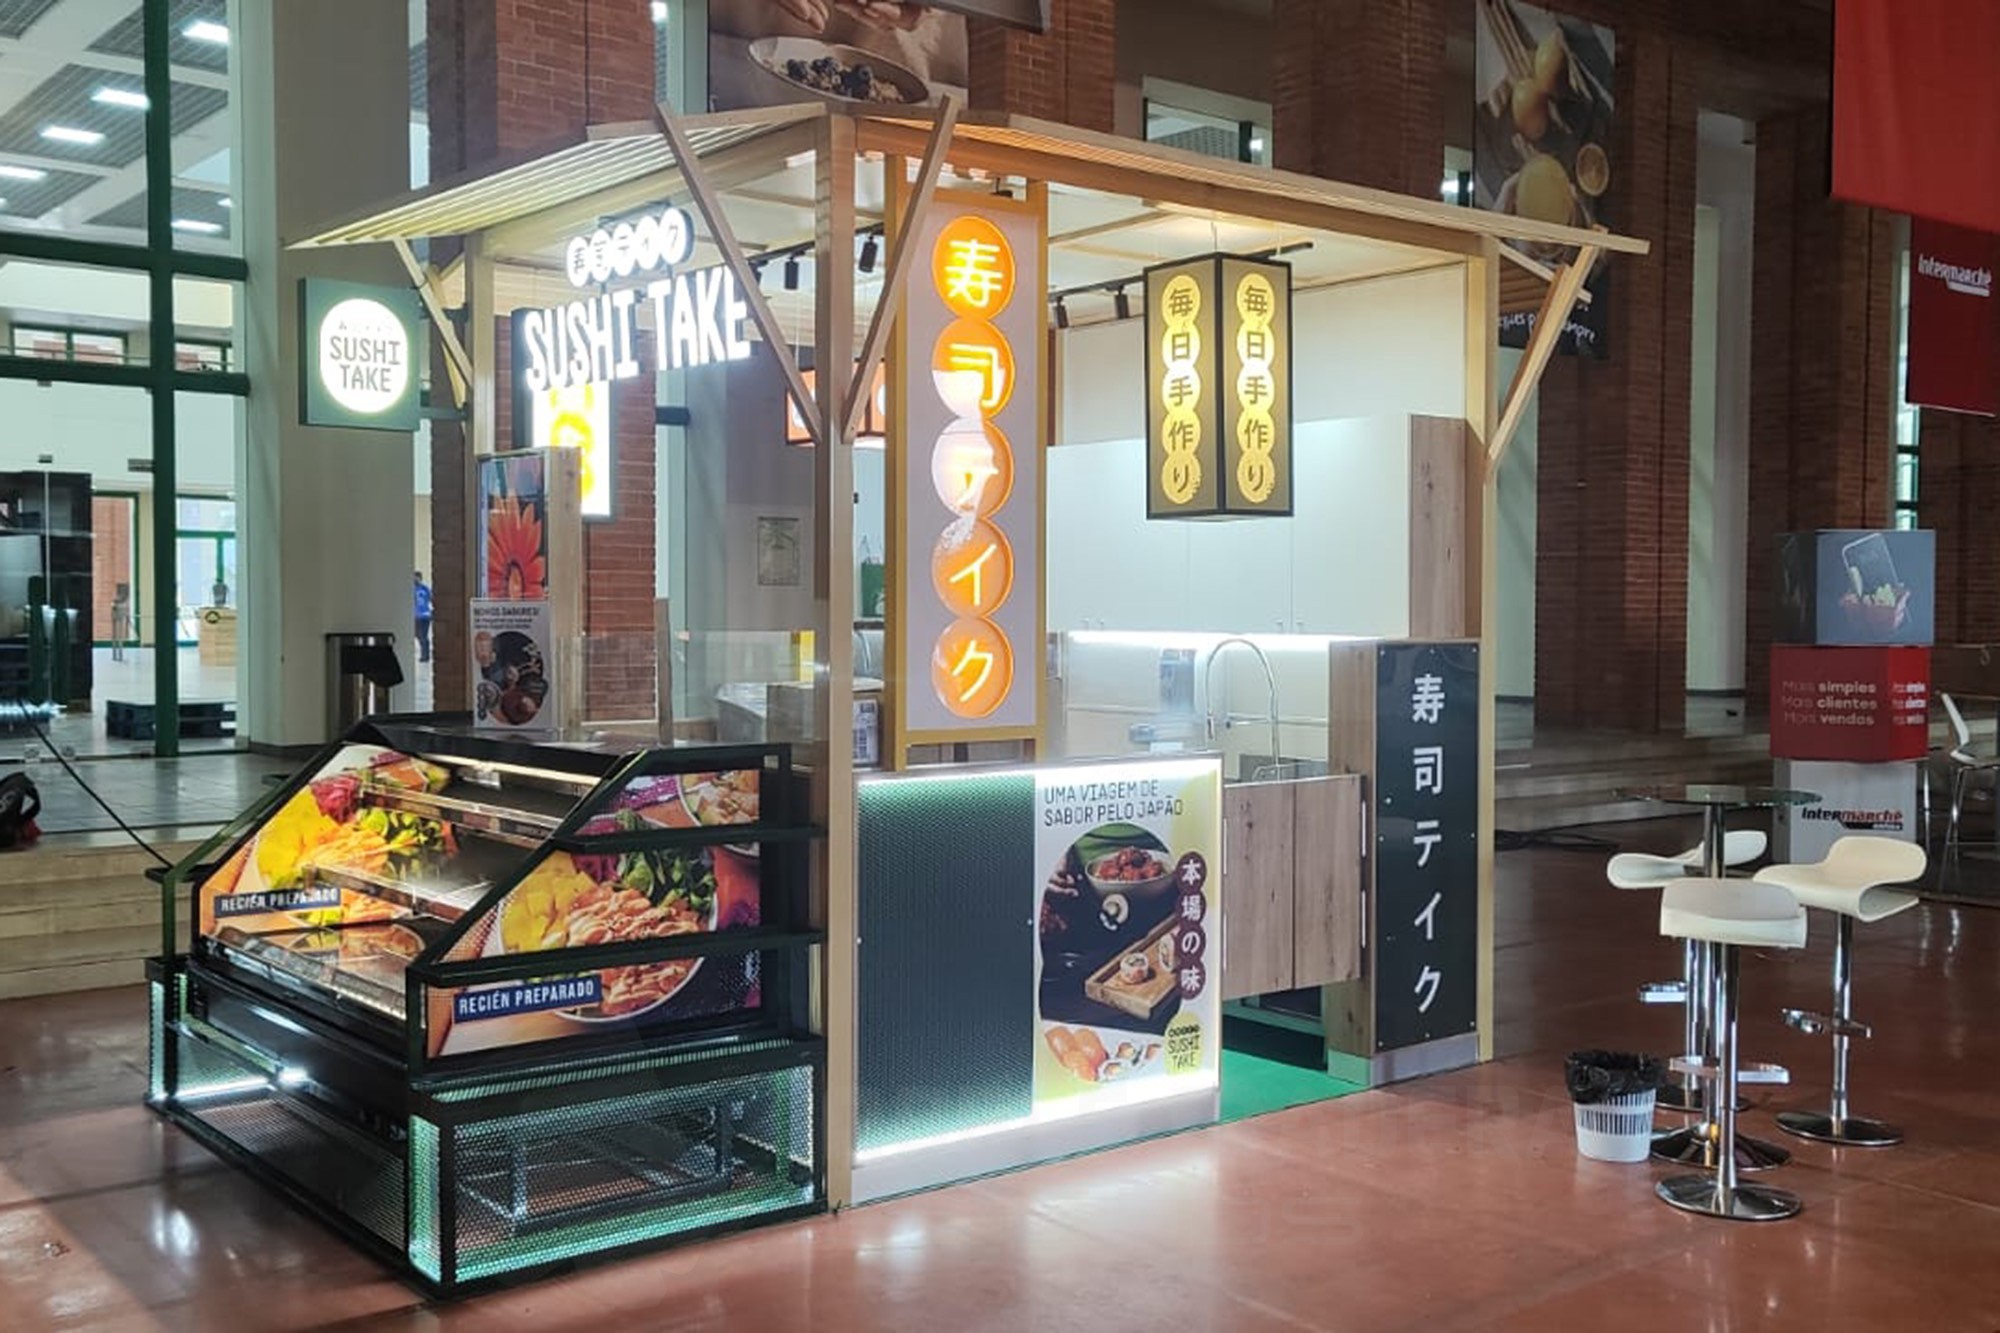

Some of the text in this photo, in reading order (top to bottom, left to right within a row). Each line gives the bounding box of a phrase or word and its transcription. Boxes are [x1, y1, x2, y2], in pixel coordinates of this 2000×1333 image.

[524, 265, 751, 391] SUSHI TAKE
[329, 335, 401, 365] SUSHI
[339, 363, 392, 393] TAKE
[1167, 286, 1195, 494] 毎日手作り
[1242, 283, 1269, 493] 毎日手作り
[1816, 696, 1878, 710] clientes
[1818, 681, 1877, 696] simples
[1819, 712, 1875, 725] vendas
[1044, 779, 1159, 805] UMA VIAGEM DE
[1044, 795, 1184, 827] SABOR PELO JAPÃO
[1411, 673, 1446, 1014] 寿司テイク
[1180, 857, 1202, 993] 本場の味
[458, 980, 594, 1015] RECIÉN PREPARADO
[1168, 1035, 1200, 1054] SUSHI
